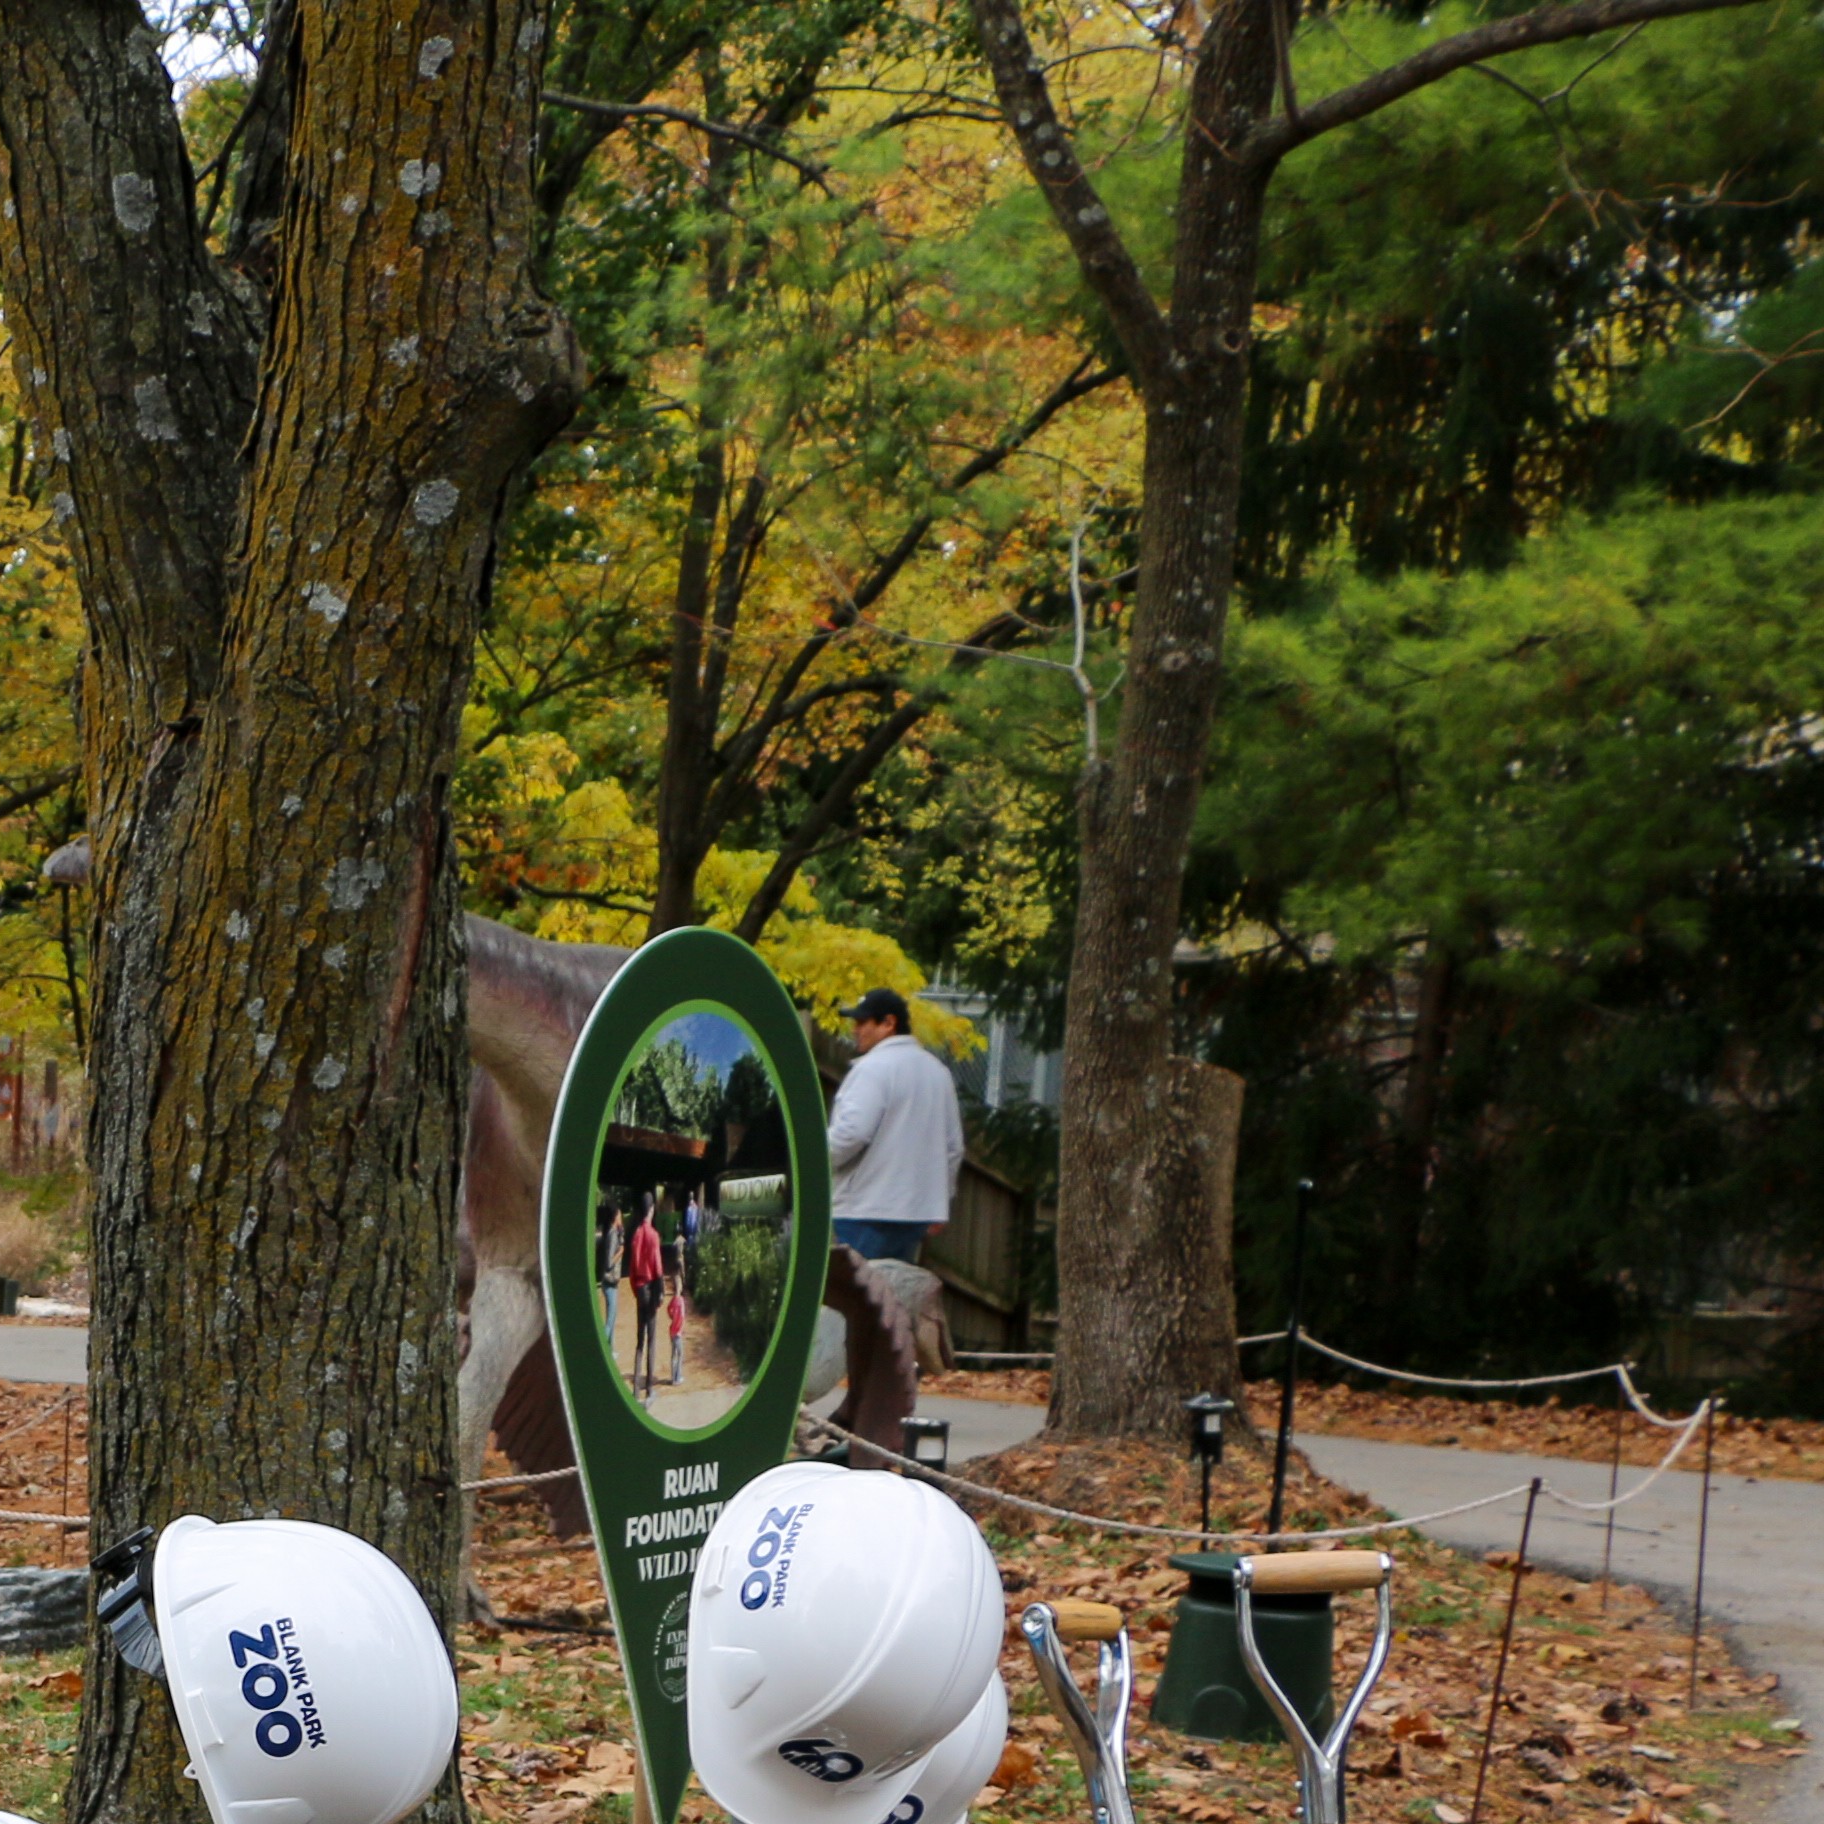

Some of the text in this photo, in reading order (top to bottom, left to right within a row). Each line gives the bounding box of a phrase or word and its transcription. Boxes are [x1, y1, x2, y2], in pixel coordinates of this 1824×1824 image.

[625, 1501, 727, 1548] FOUNDATI
[663, 1461, 719, 1499] RUAN
[638, 1550, 688, 1581] WILD
[740, 1505, 798, 1611] ZOO
[771, 1504, 815, 1608] BLANK PARK
[229, 1623, 303, 1758] ZOO
[276, 1617, 327, 1749] BLANK PARK
